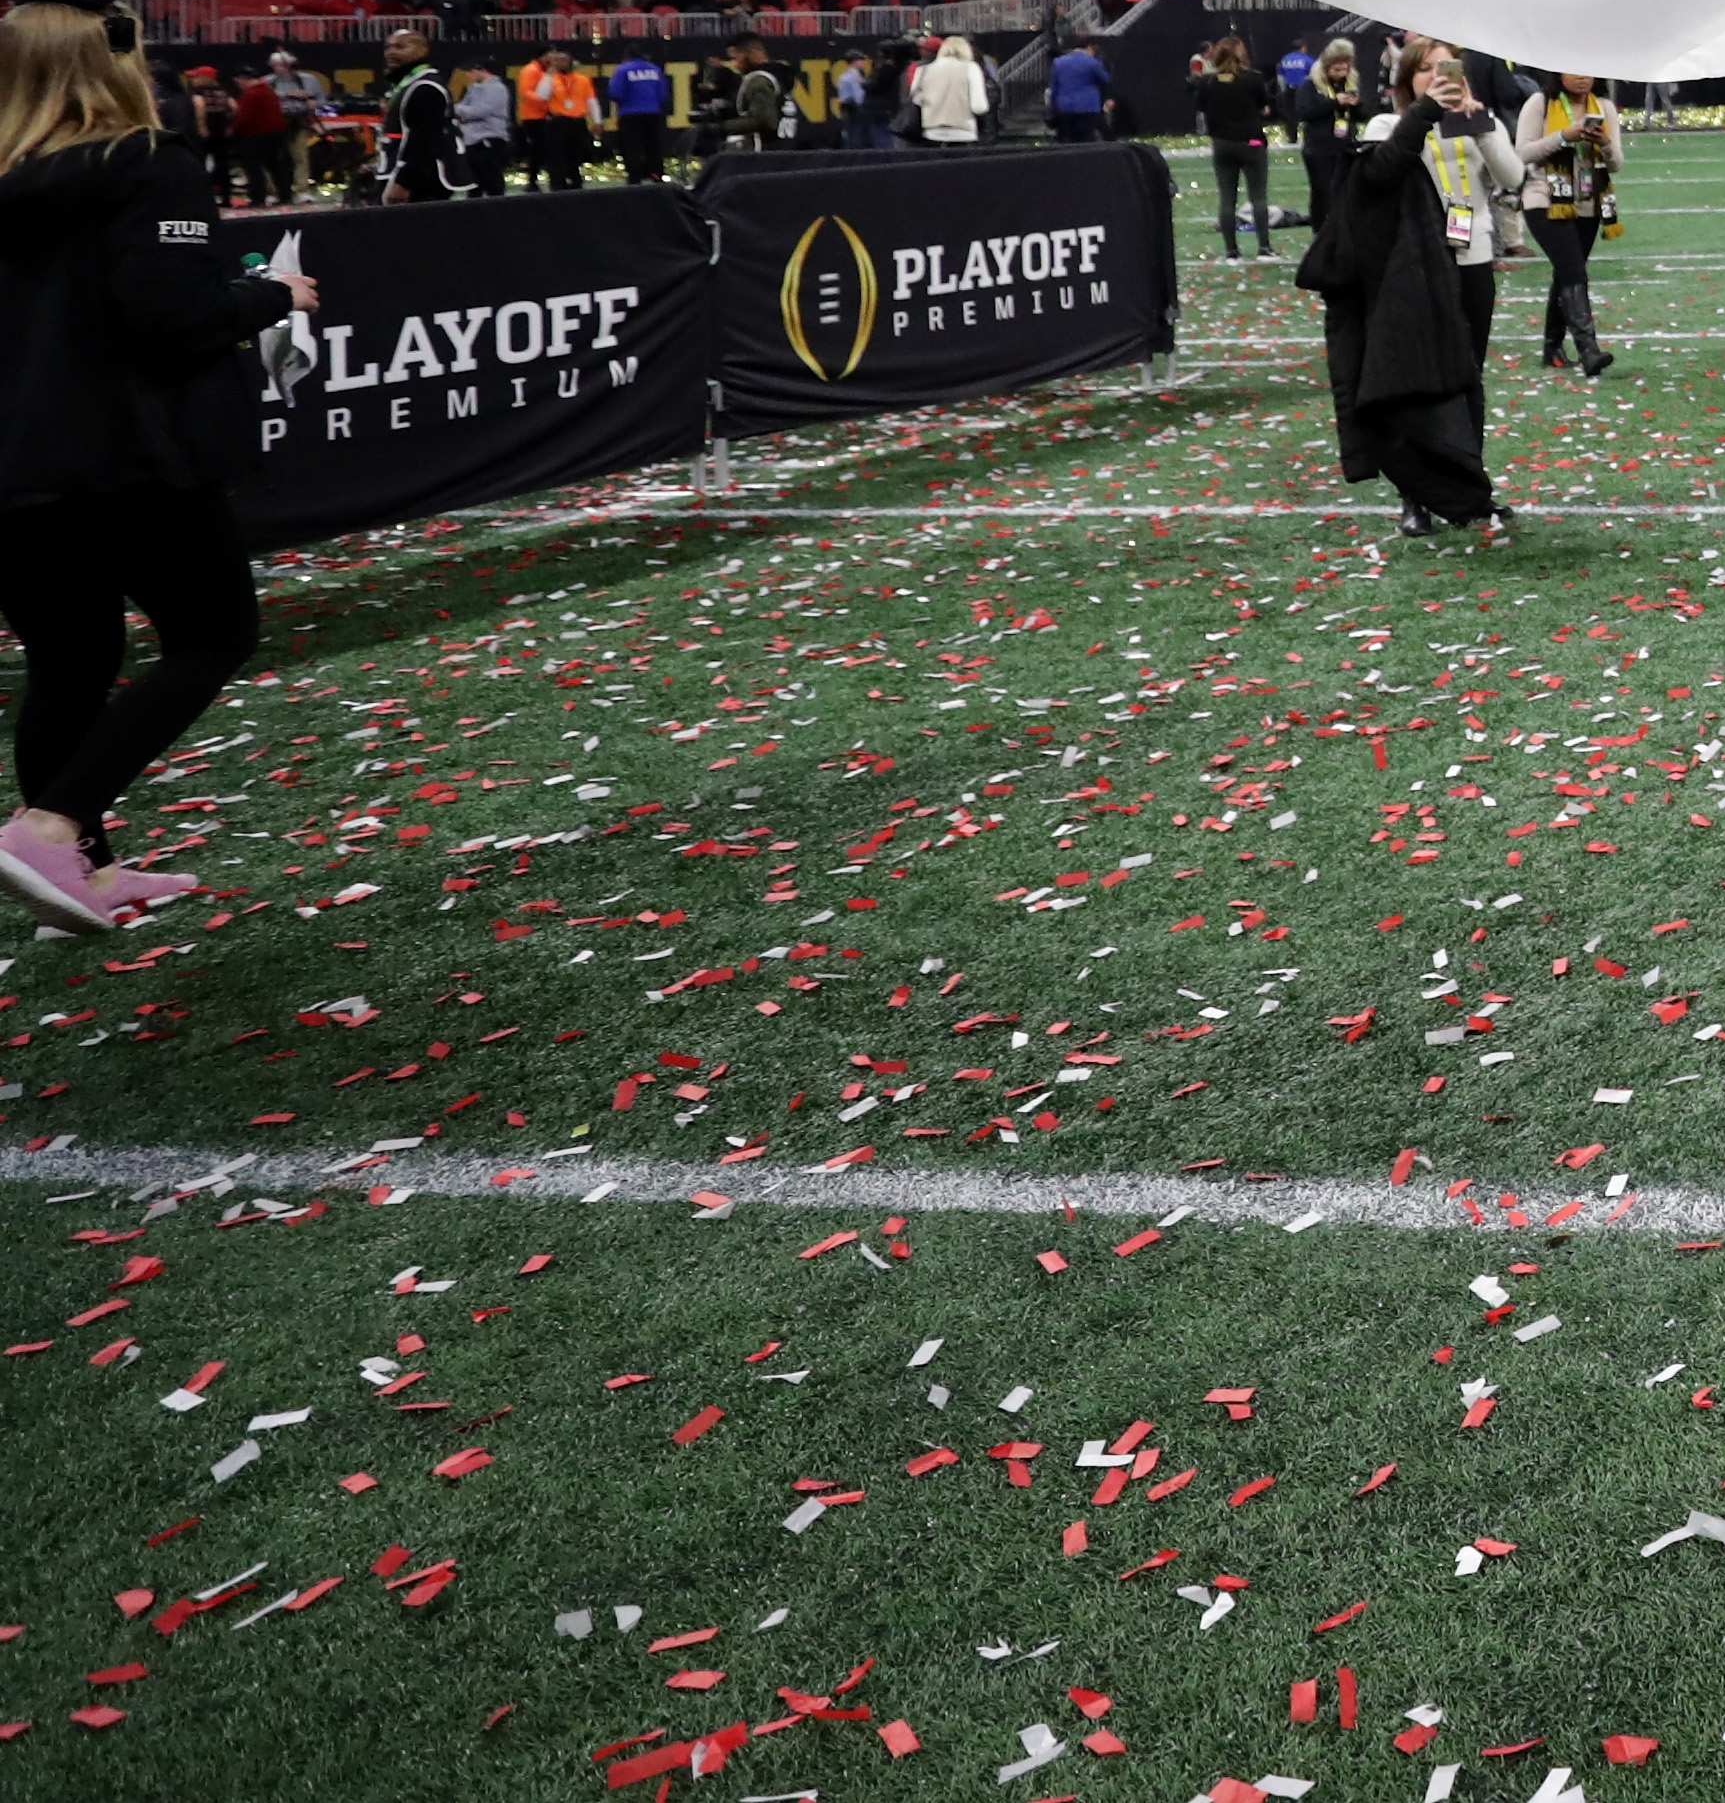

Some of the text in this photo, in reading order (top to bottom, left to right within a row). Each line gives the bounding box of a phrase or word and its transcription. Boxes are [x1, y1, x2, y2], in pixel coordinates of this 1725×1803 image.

[892, 225, 1105, 300] PLAYOFF
[893, 281, 1110, 337] PREMIUM
[261, 356, 640, 452] PREMIUM
